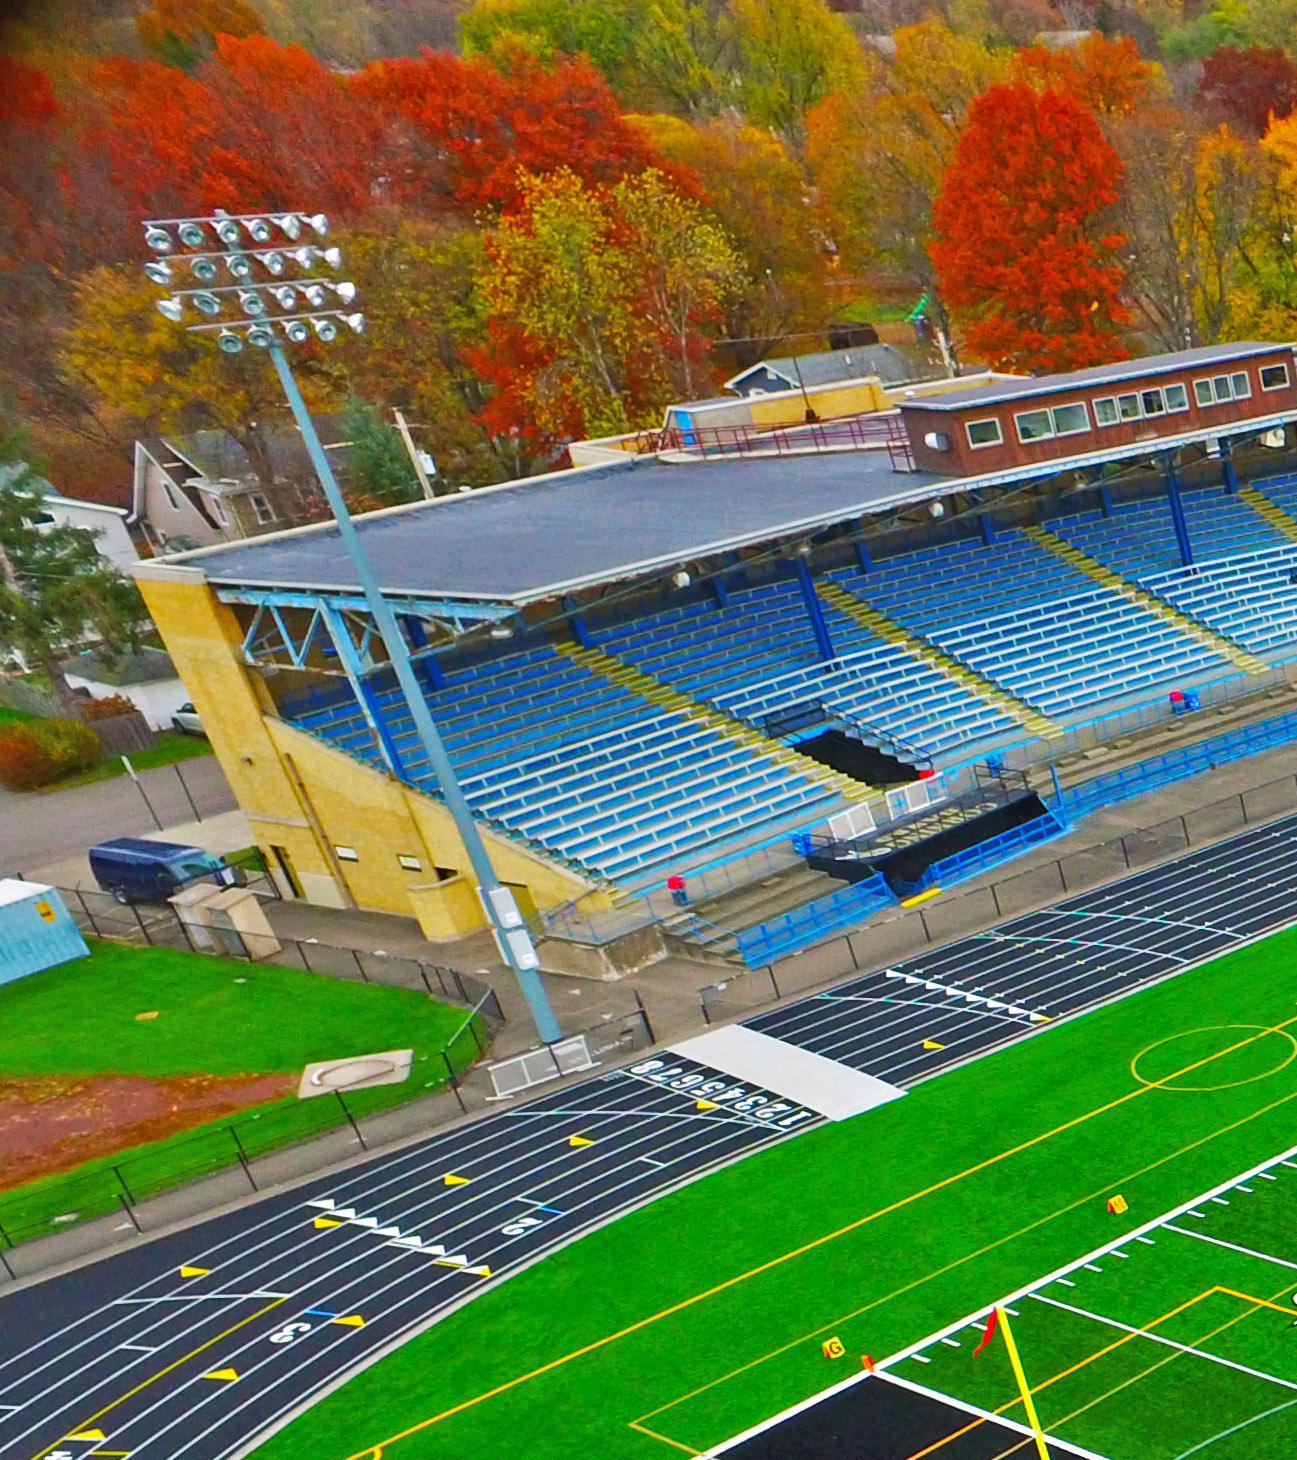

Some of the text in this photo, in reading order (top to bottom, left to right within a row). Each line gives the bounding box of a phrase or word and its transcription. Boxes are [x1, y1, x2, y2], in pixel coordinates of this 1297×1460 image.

[502, 1217, 543, 1235] 2
[269, 1322, 311, 1343] 3
[829, 1341, 842, 1354] G
